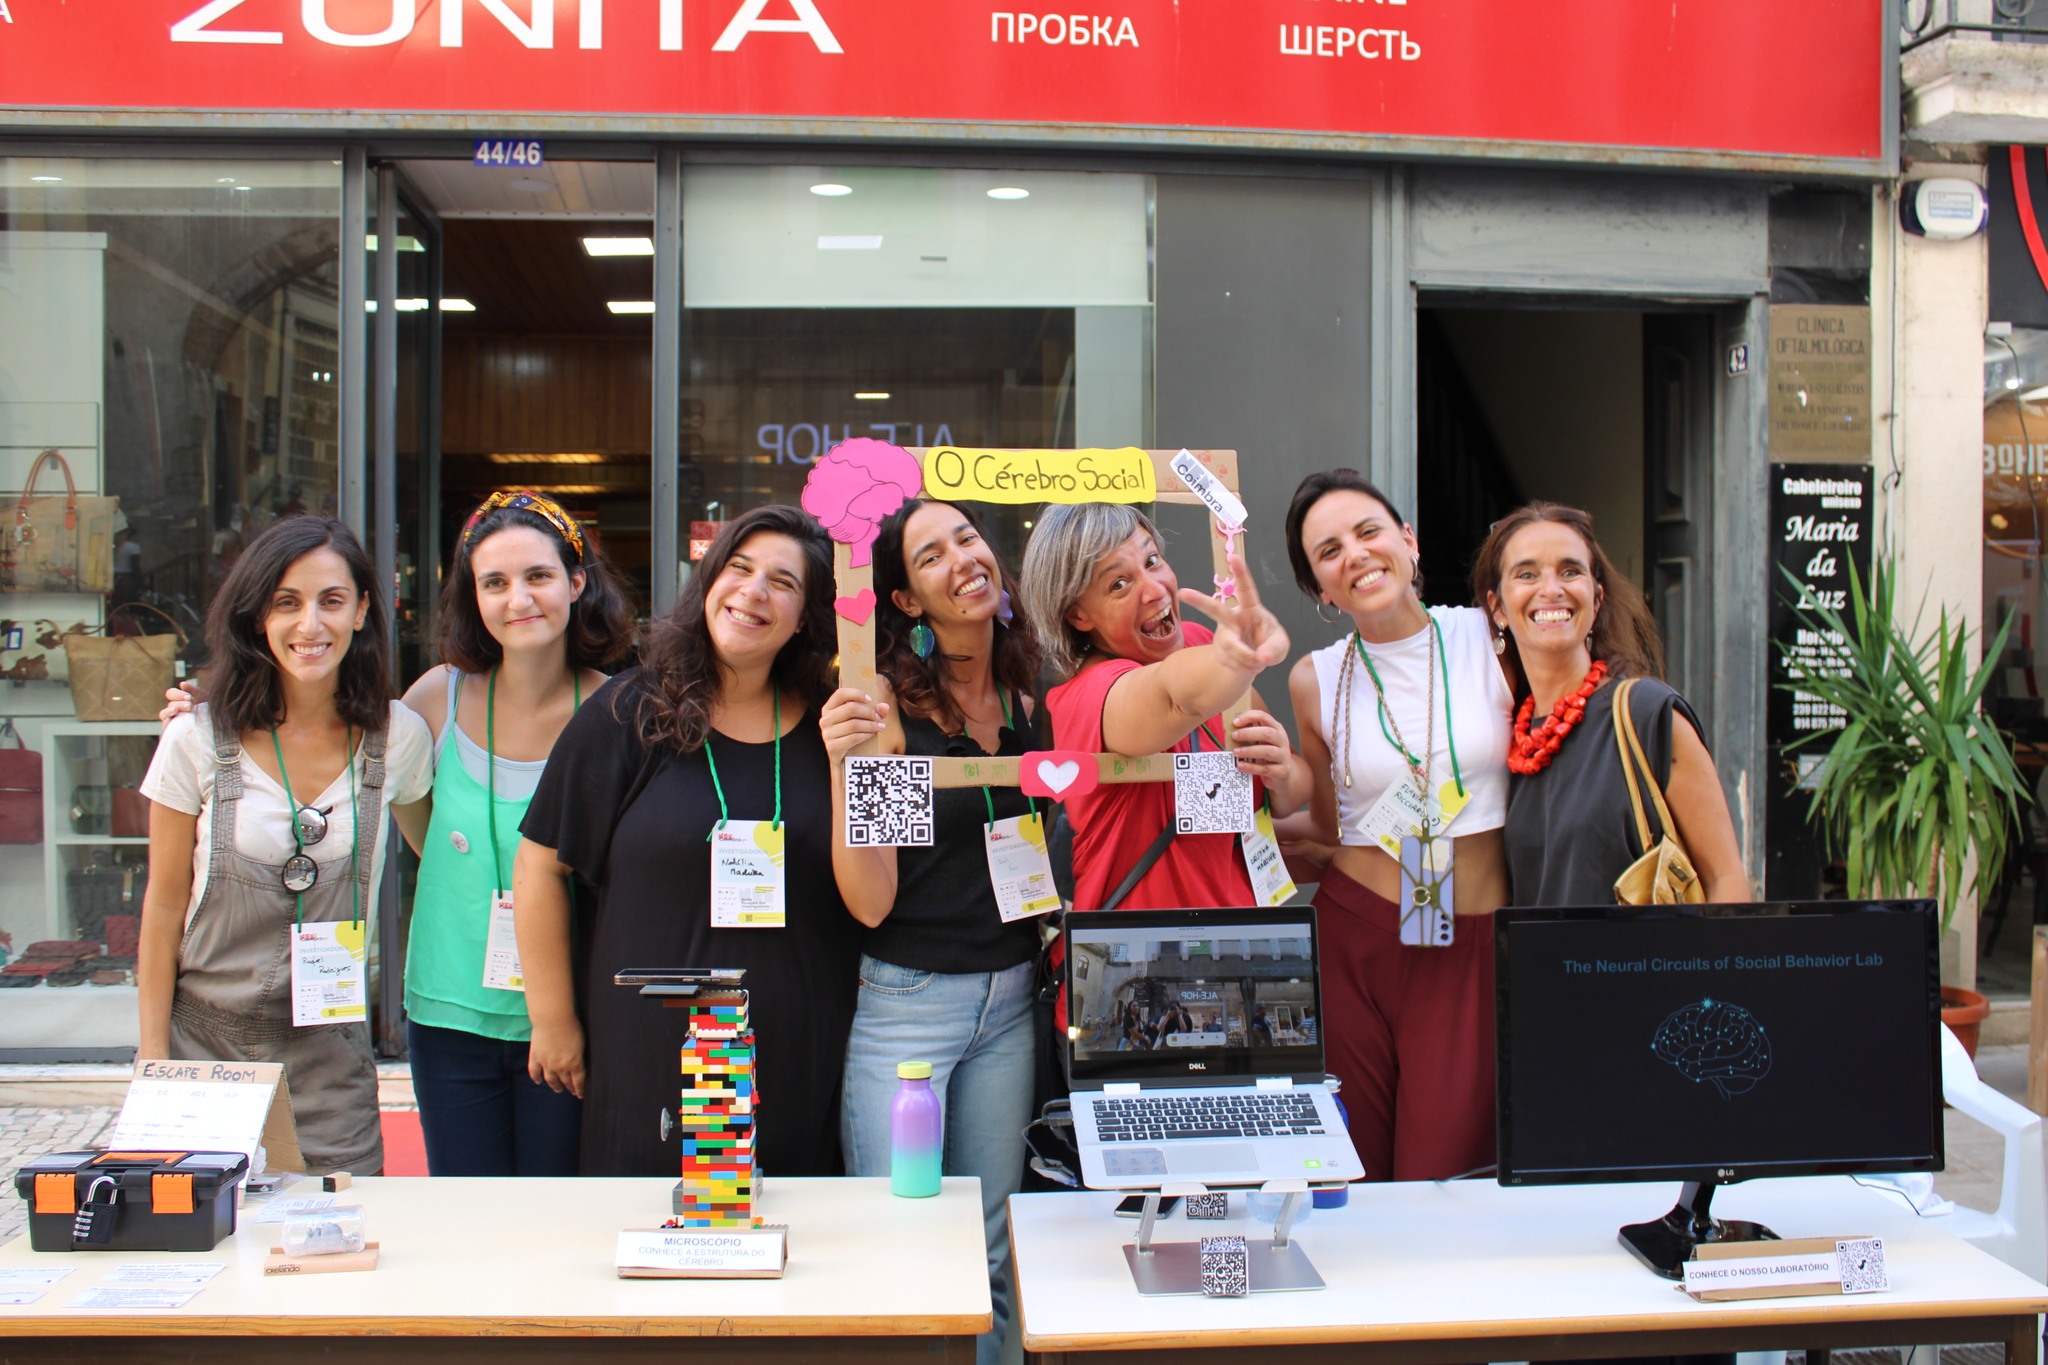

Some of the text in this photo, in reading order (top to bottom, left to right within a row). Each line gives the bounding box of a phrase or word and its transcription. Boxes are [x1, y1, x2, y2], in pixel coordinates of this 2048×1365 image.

[991, 12, 1139, 47] ПРОБКА
[1280, 24, 1421, 60] ШЕРСТЬ
[476, 141, 541, 165] 44/46
[1797, 316, 1845, 333] CLÍNICA
[1776, 337, 1865, 355] OFTALMOLÓGICA
[935, 450, 1146, 491] O Cérebro Social
[1177, 464, 1223, 513] Coimbra
[1783, 478, 1863, 496] Cabeleireiro
[1821, 496, 1862, 509] unisexo
[1785, 515, 1860, 542] Maria
[1806, 548, 1837, 577] da
[1796, 584, 1847, 610] Luz
[1563, 953, 1883, 973] The Neural Circuits of Social Behavior Lab
[638, 1246, 765, 1257] CONHECE A ESTRUTURA DO
[664, 1236, 742, 1247] MICROSCÓPIO
[679, 1257, 724, 1266] CÉREBRO
[1689, 1262, 1829, 1279] CONHECE O NOSSO LABORATÓRIO
